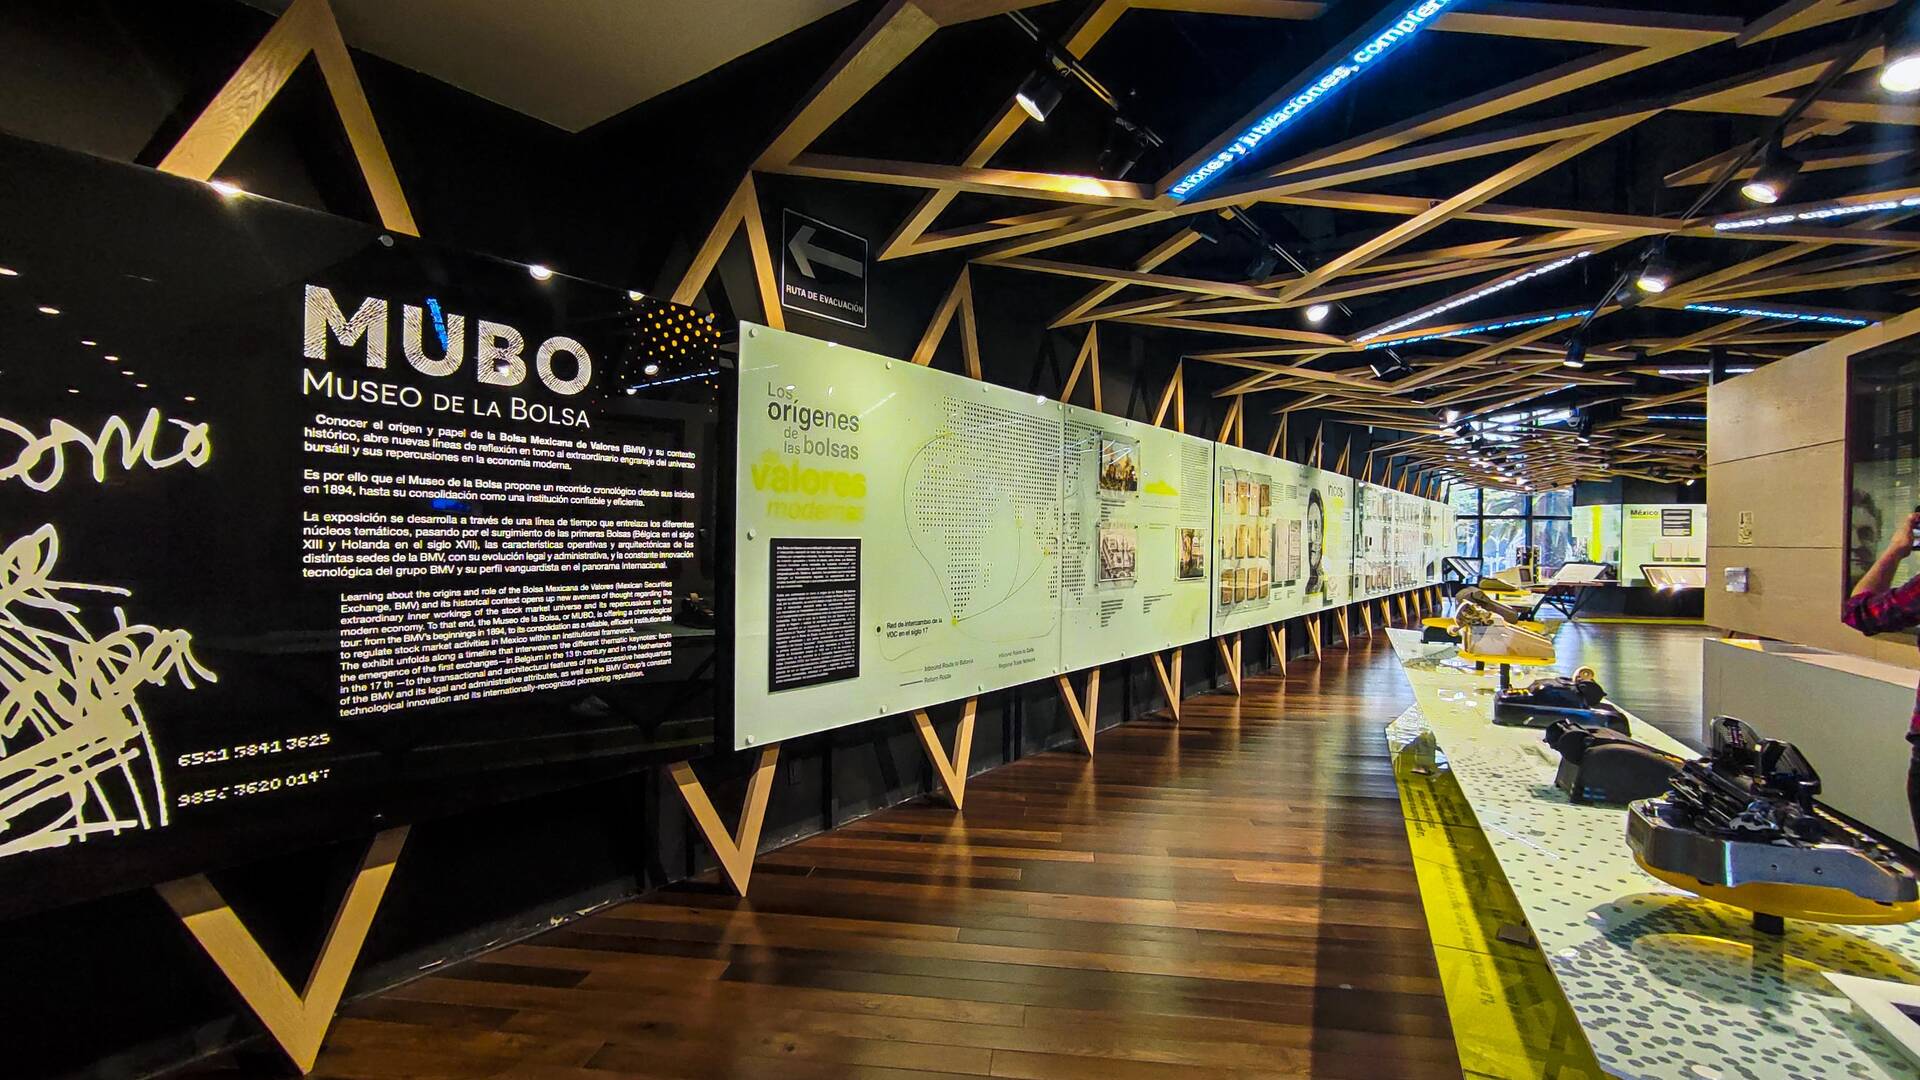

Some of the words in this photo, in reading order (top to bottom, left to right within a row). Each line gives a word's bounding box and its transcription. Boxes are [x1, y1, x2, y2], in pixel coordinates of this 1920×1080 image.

[1228, 142, 1250, 156] y
[1241, 63, 1360, 147] jubilaciones,
[786, 284, 806, 298] RUTA
[807, 290, 818, 301] DE
[819, 293, 864, 314] EVACUACIÓN
[303, 285, 592, 395] MUBO
[302, 368, 422, 408] MUSEO
[433, 393, 465, 413] DE
[473, 398, 502, 418] LA
[511, 397, 590, 428] BOLSA
[767, 381, 793, 400] Los
[767, 399, 860, 432] orígenes
[316, 415, 367, 429] Conocer
[373, 421, 383, 431] el
[388, 422, 422, 435] origen
[427, 428, 434, 438] y
[438, 429, 466, 440] papel
[470, 429, 482, 440] de
[487, 430, 496, 441] la
[500, 431, 526, 443] Bolsa
[530, 434, 573, 446] Mexicana
[576, 437, 587, 448] de
[590, 438, 620, 451] Valores
[784, 426, 798, 439] de
[784, 440, 801, 455] las
[803, 434, 859, 460] bolsas
[304, 442, 349, 455] bursátil
[352, 447, 359, 457] y
[362, 448, 383, 457] sus
[386, 449, 459, 462] repercusiones
[461, 455, 473, 463] en
[476, 454, 484, 464] la
[486, 457, 530, 468] economía
[532, 459, 573, 471] moderna.
[304, 470, 320, 480] Es
[323, 473, 344, 483] por
[347, 472, 368, 482] ello
[371, 475, 393, 485] que
[396, 474, 405, 484] el
[408, 475, 445, 486] Museo
[447, 476, 461, 487] de
[463, 477, 472, 488] la
[475, 478, 502, 489] Bolsa
[504, 482, 541, 493] propone
[543, 484, 554, 492] un
[556, 483, 591, 494] recorrido
[593, 485, 636, 497] cronológico
[751, 459, 867, 497] valores
[304, 486, 319, 494] en
[324, 485, 357, 498] 1894,
[359, 486, 390, 497] hasta
[393, 489, 406, 497] su
[408, 488, 478, 500] consolidación
[480, 492, 506, 501] como
[508, 493, 524, 502] una
[526, 492, 568, 504] institución
[570, 495, 605, 505] confiable
[303, 511, 319, 522] La
[324, 512, 386, 524] exposición
[390, 515, 404, 523] se
[407, 513, 457, 524] desarrolla
[460, 516, 467, 525] a
[470, 515, 498, 525] través
[501, 515, 513, 525] de
[516, 517, 532, 526] una
[535, 516, 554, 526] línea
[557, 516, 568, 527] de
[570, 517, 597, 529] tiempo
[600, 519, 614, 529] que
[303, 526, 351, 536] núcleos
[354, 526, 412, 538] temáticos,
[415, 526, 459, 538] pasando
[462, 528, 478, 539] por
[481, 527, 489, 537] el
[491, 527, 542, 539] surgimiento
[544, 528, 555, 538] de
[558, 528, 568, 538] las
[571, 528, 604, 540] primeras
[303, 539, 322, 549] XIII
[328, 541, 336, 551] y
[342, 539, 390, 549] Holanda
[394, 541, 408, 549] en
[413, 539, 422, 549] el
[427, 539, 451, 551] siglo
[456, 539, 481, 551] XVII),
[484, 539, 498, 549] las
[502, 539, 563, 550] características
[567, 539, 607, 551] operativas
[340, 661, 359, 670] The
[362, 657, 393, 668] exhibit
[396, 655, 429, 665] unfolds
[432, 653, 455, 662] along
[465, 648, 496, 659] timeline
[498, 646, 513, 655] that
[515, 643, 558, 654] interweaves
[560, 640, 571, 649] the
[572, 637, 599, 648] different
[600, 635, 627, 645] thematic
[178, 748, 229, 767] 6521
[286, 733, 330, 750] 3625
